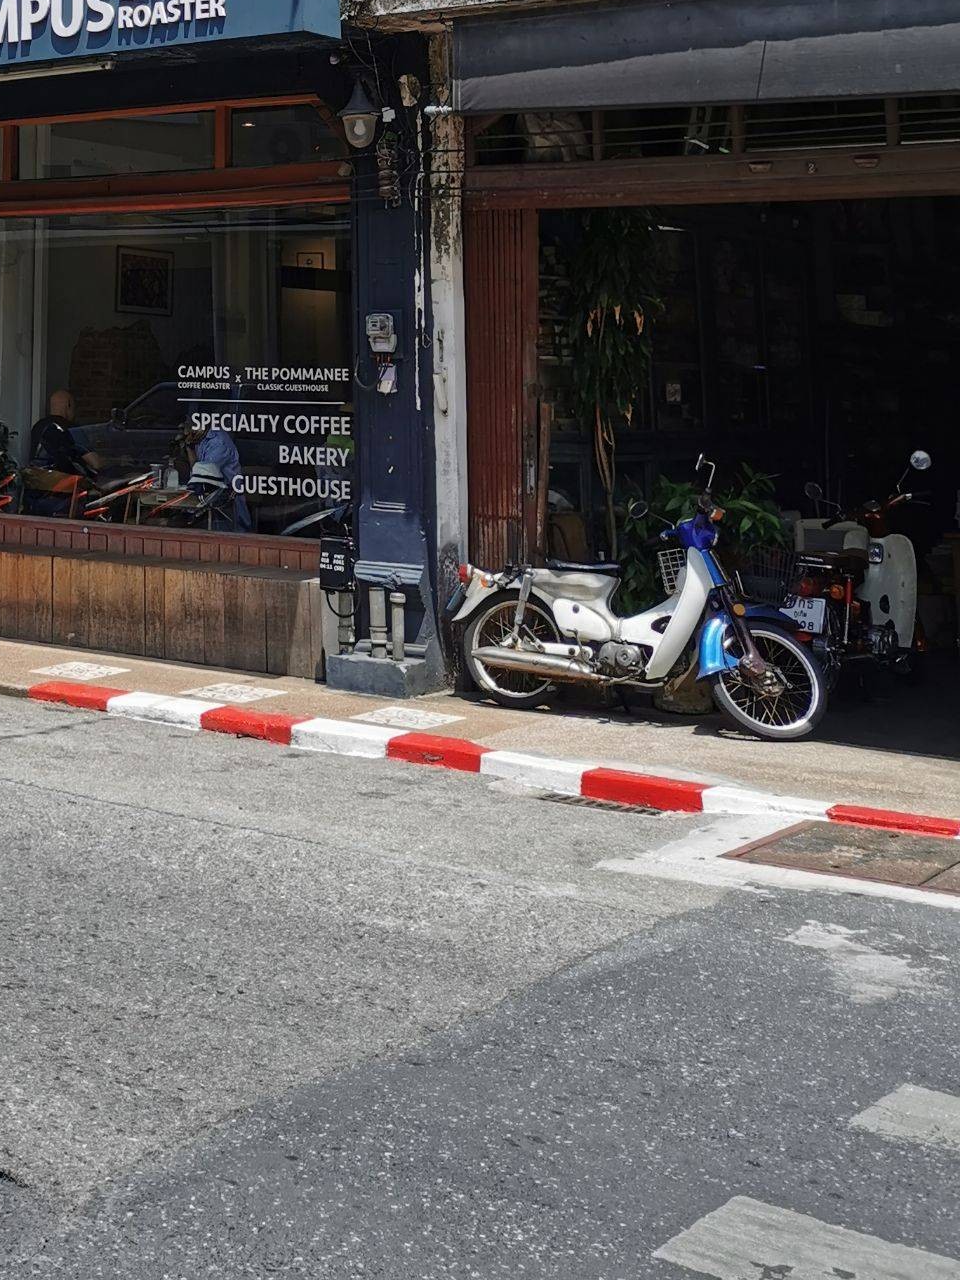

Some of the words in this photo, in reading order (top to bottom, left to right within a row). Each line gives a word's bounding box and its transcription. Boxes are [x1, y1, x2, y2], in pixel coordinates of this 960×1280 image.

[177, 365, 230, 379] CAMPUS
[245, 367, 269, 380] THE
[177, 381, 201, 389] COFFEE
[201, 382, 230, 390] ROASTER
[257, 383, 283, 391] CLASSIC
[284, 383, 329, 392] GUESTHOUSE
[191, 412, 279, 433] SPECIALTY
[283, 415, 351, 435] COFFEE
[279, 445, 350, 467] BAKERY
[232, 474, 351, 500] GUESTHOUSE
